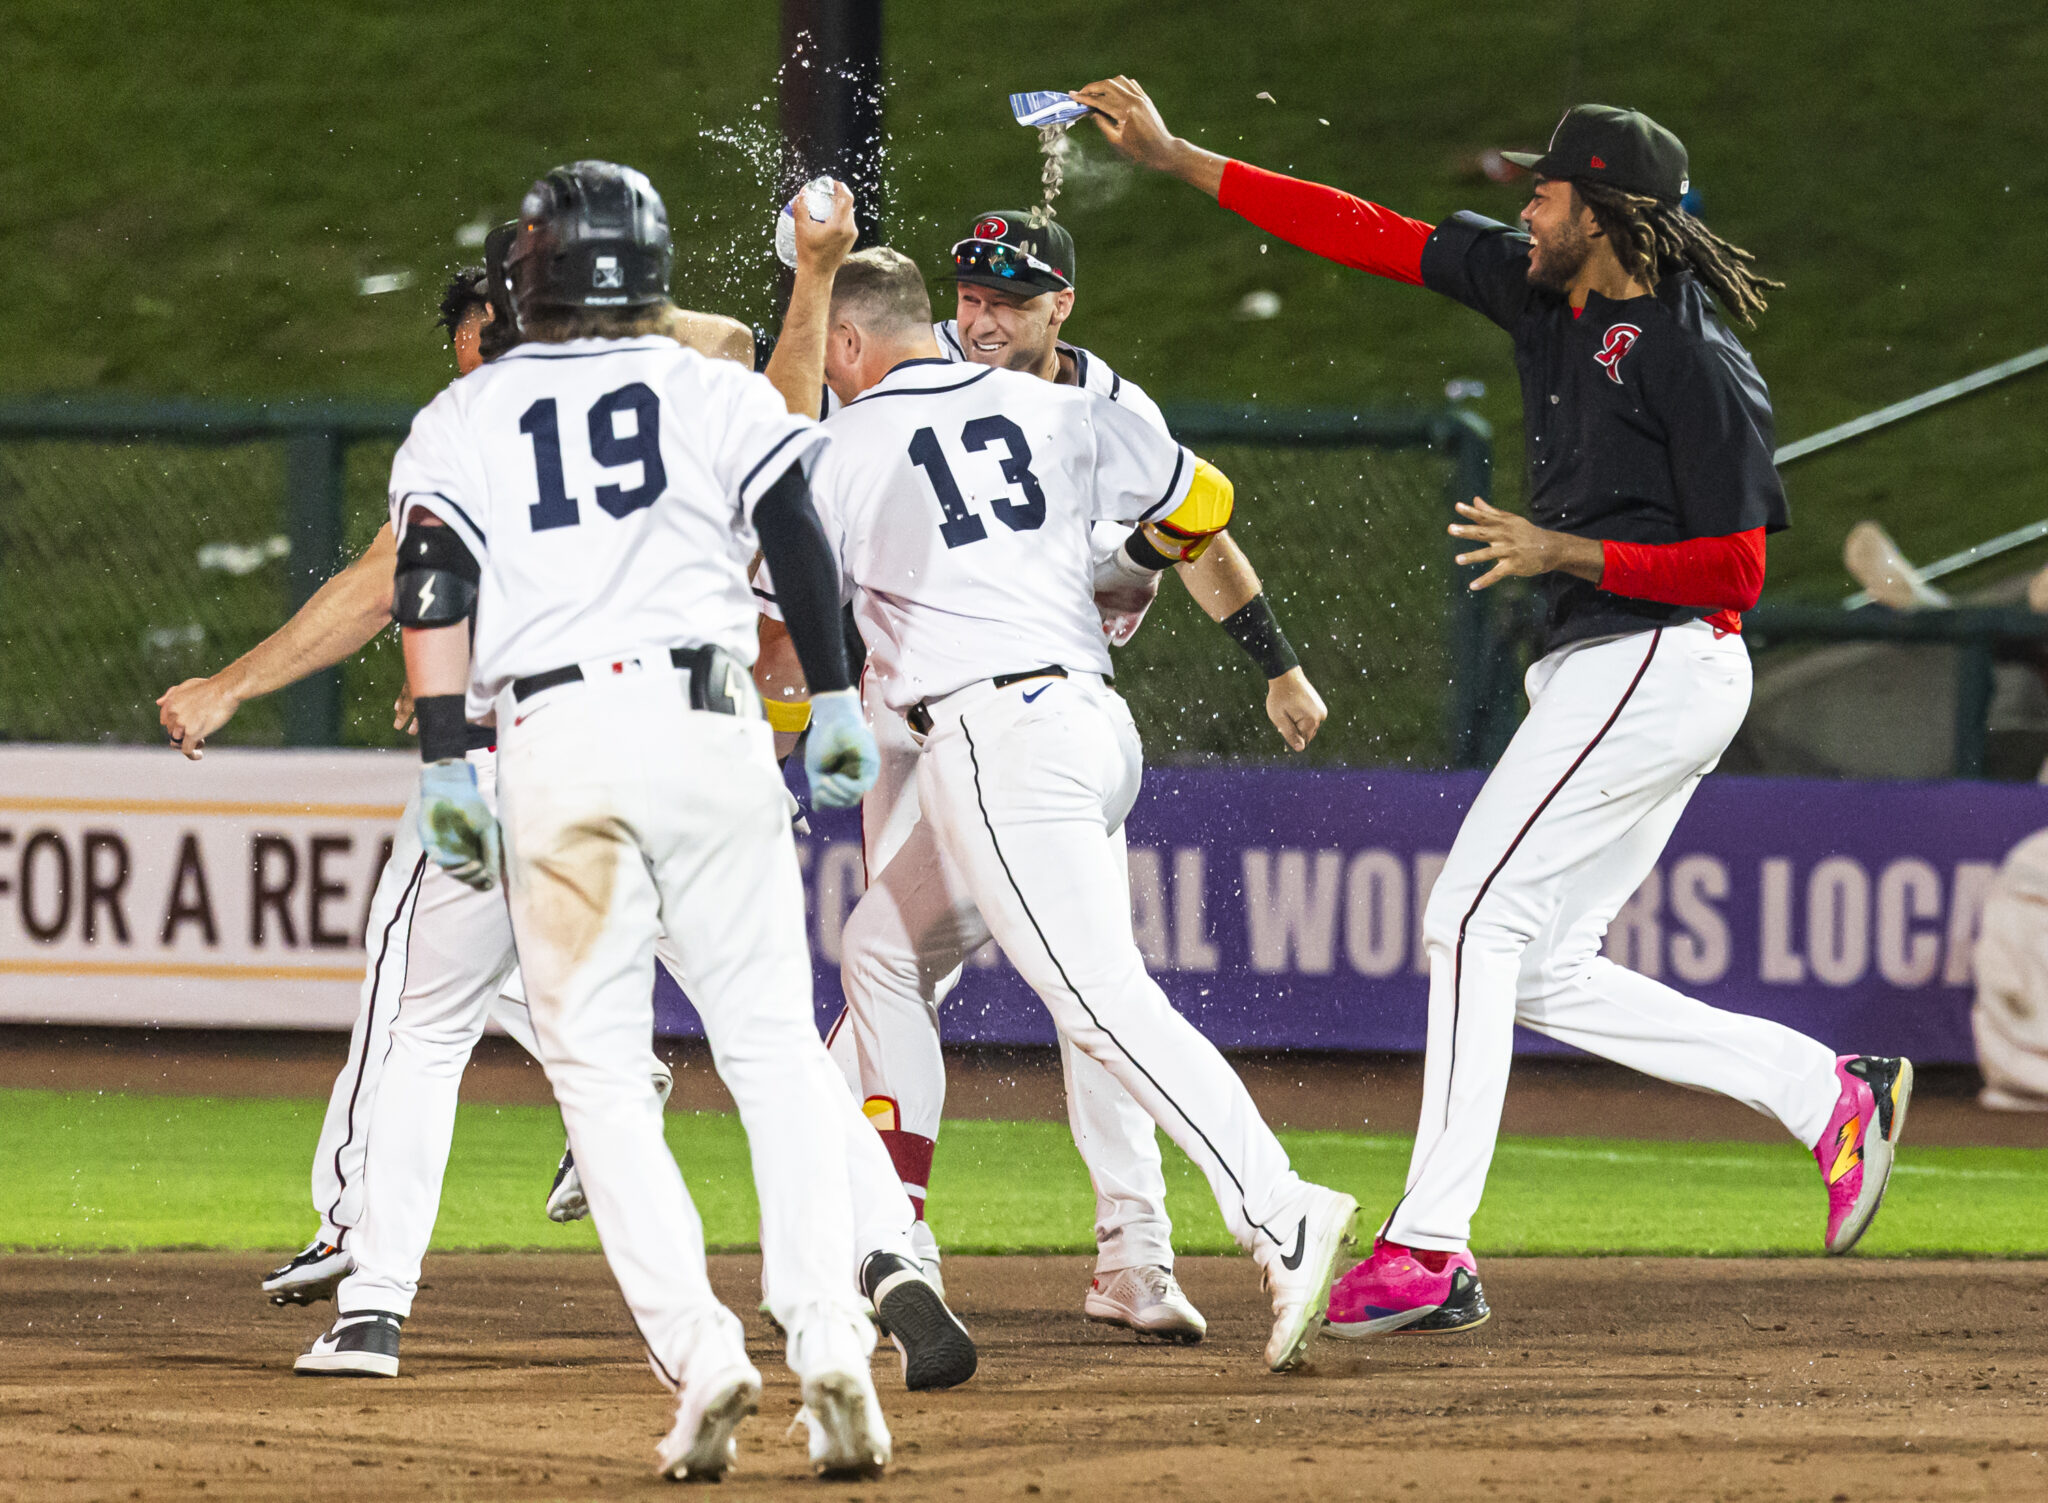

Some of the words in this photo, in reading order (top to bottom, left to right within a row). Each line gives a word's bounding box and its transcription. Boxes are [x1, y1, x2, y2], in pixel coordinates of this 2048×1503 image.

[519, 381, 668, 533] 19
[908, 413, 1047, 550] 13
[162, 831, 218, 947] A
